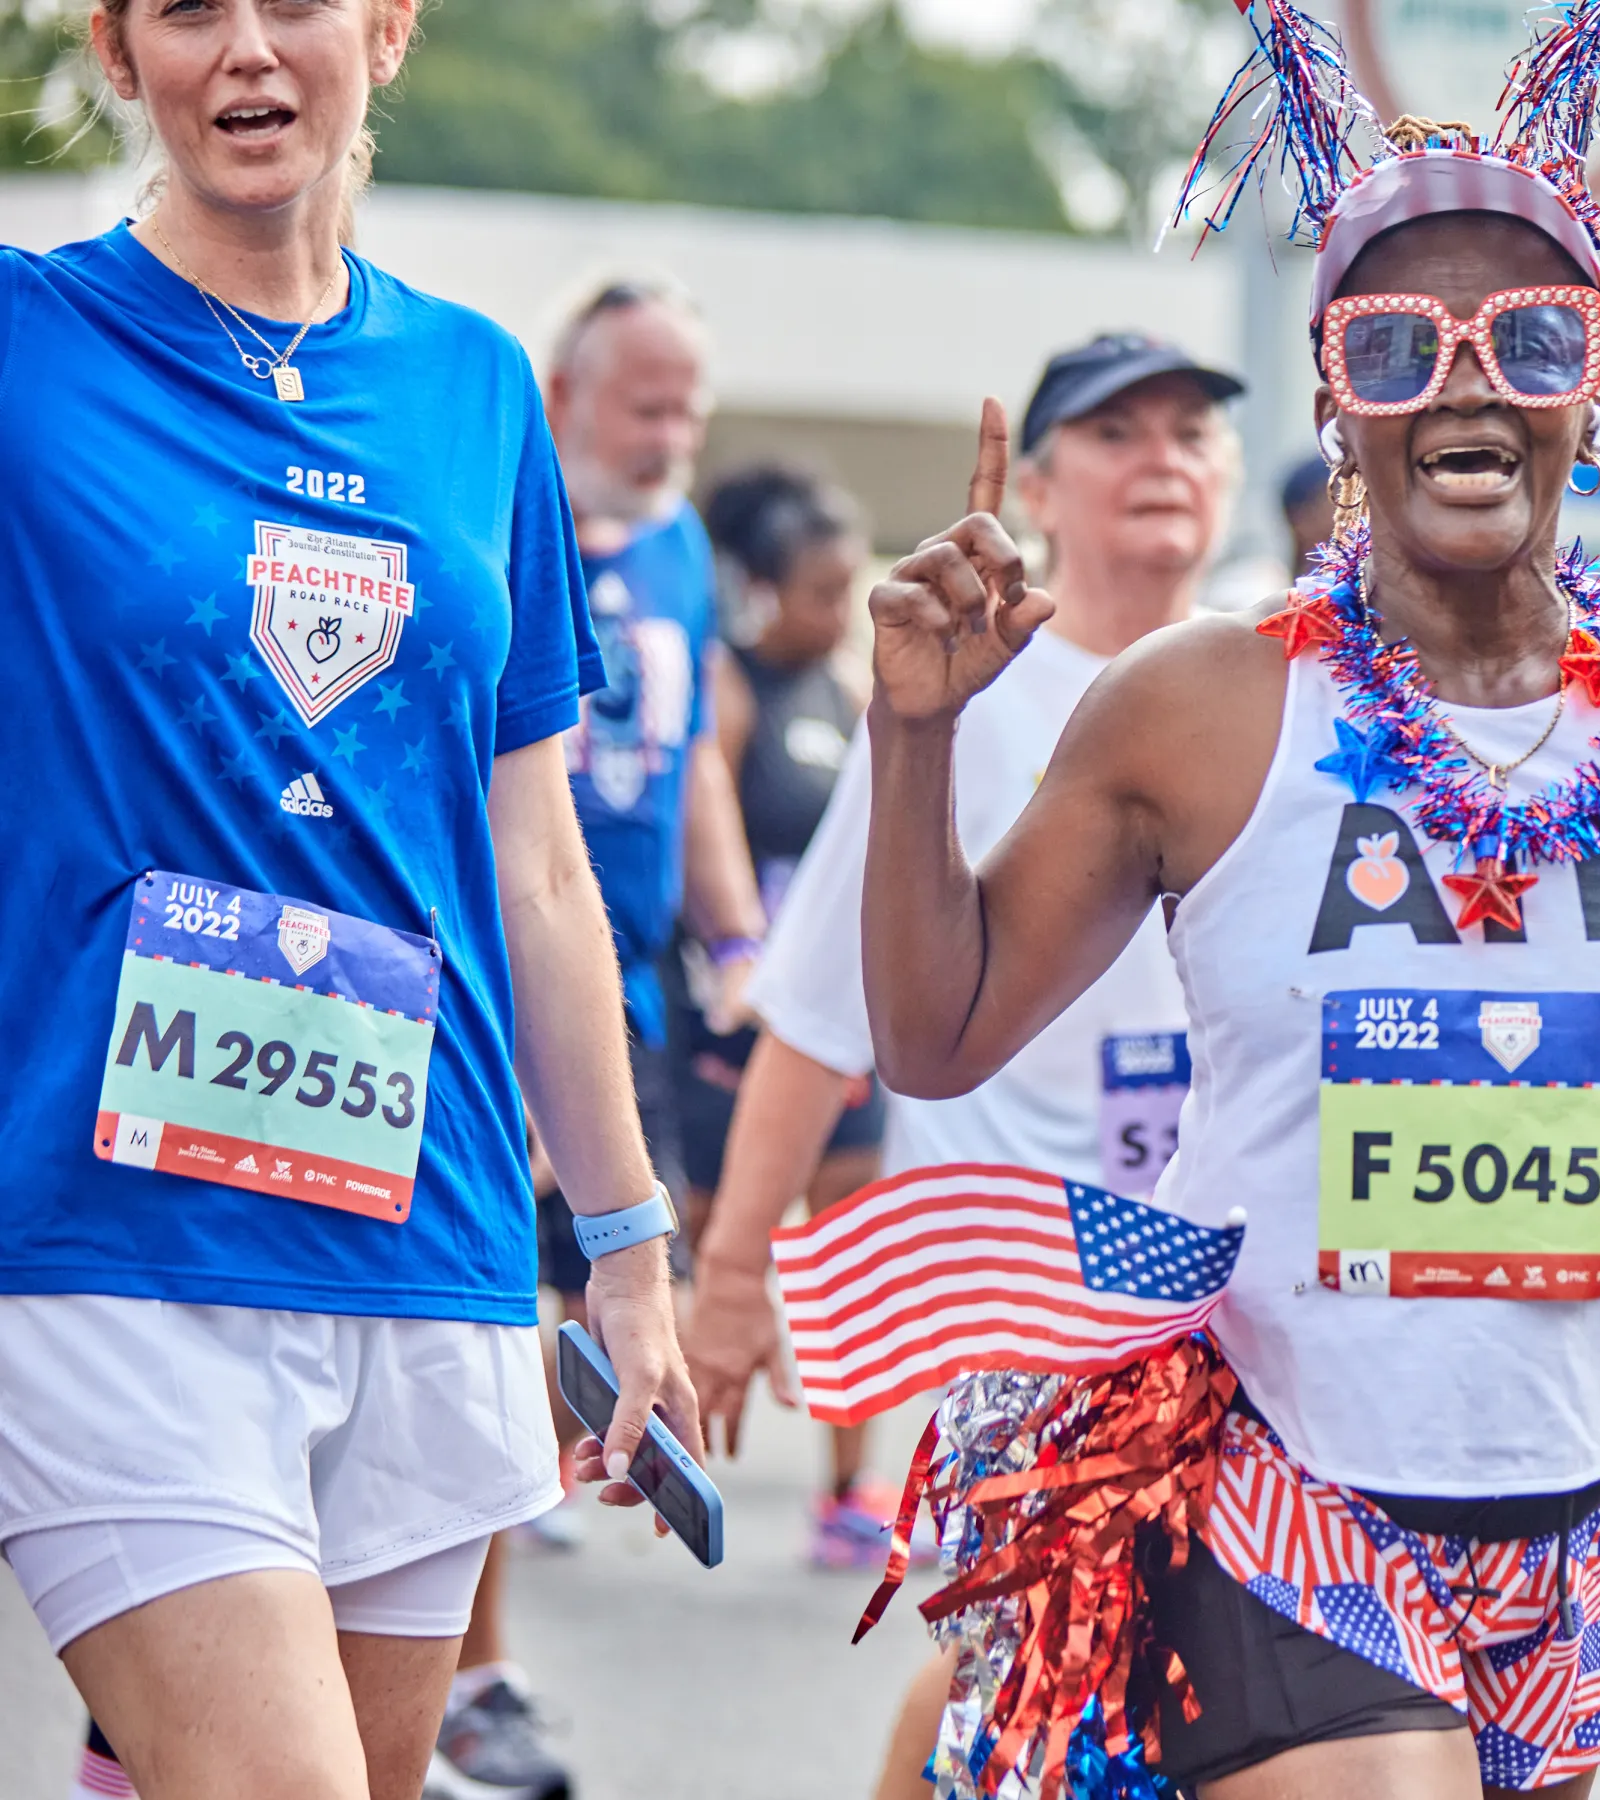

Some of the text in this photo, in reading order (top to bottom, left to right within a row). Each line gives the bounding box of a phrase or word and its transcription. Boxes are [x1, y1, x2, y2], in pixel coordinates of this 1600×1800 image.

[286, 466, 366, 504] 2022
[288, 538, 377, 561] Journal-Constitution
[307, 533, 357, 549] The Atlanta
[252, 559, 409, 610] PEACHTREE
[290, 590, 369, 613] ROAD RACE
[280, 796, 333, 818] adidas
[166, 881, 241, 915] JULY 4
[163, 903, 240, 941] 2022
[280, 920, 328, 938] PEACHTREE
[1355, 997, 1439, 1020] JULY 4
[1355, 1021, 1439, 1049] 2022
[115, 1001, 416, 1129] M 29553
[1121, 1121, 1149, 1168] S
[1352, 1131, 1392, 1200] F
[316, 1172, 337, 1185] PNC
[345, 1179, 391, 1200] POWERADE
